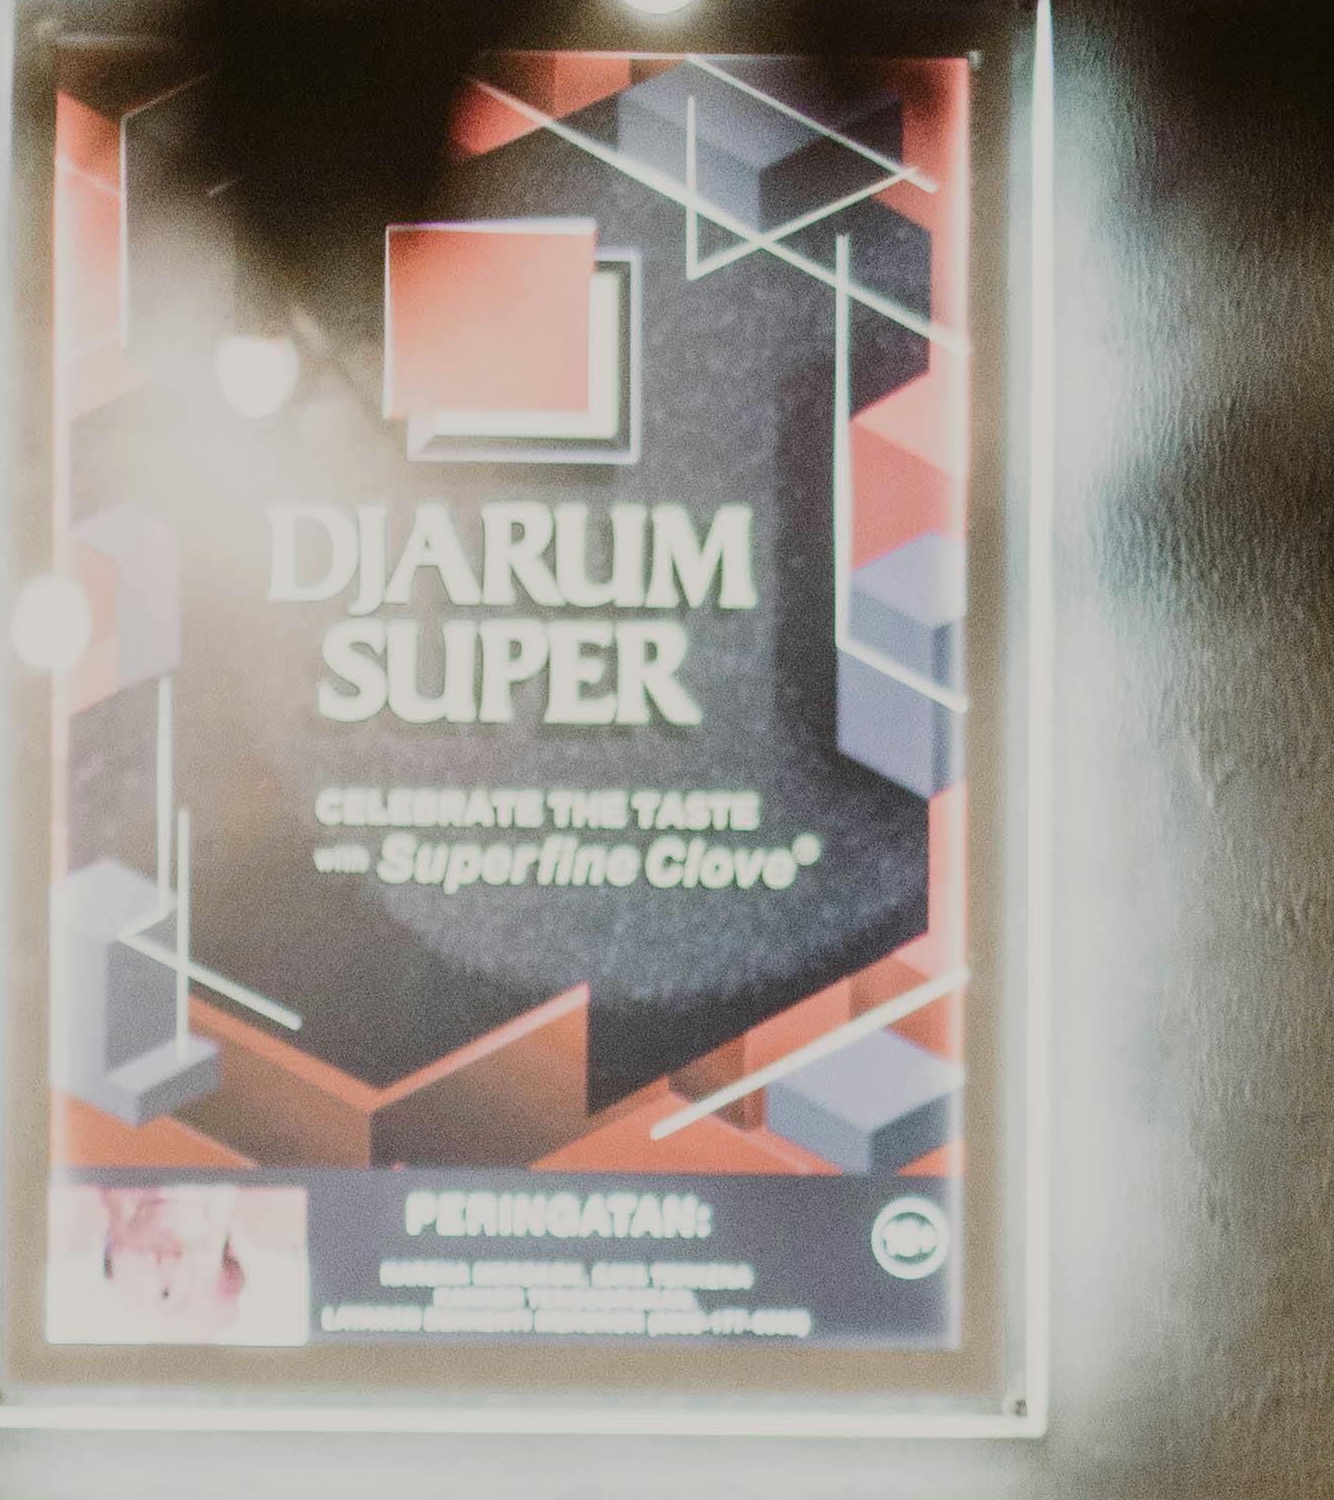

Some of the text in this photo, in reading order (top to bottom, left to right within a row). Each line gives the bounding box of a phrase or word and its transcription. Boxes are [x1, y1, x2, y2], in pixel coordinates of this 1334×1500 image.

[267, 498, 759, 617] DJARUM
[317, 618, 704, 726] SUPER
[315, 788, 762, 831] CELEBRATE THE TASTE
[376, 832, 642, 895] Superfine
